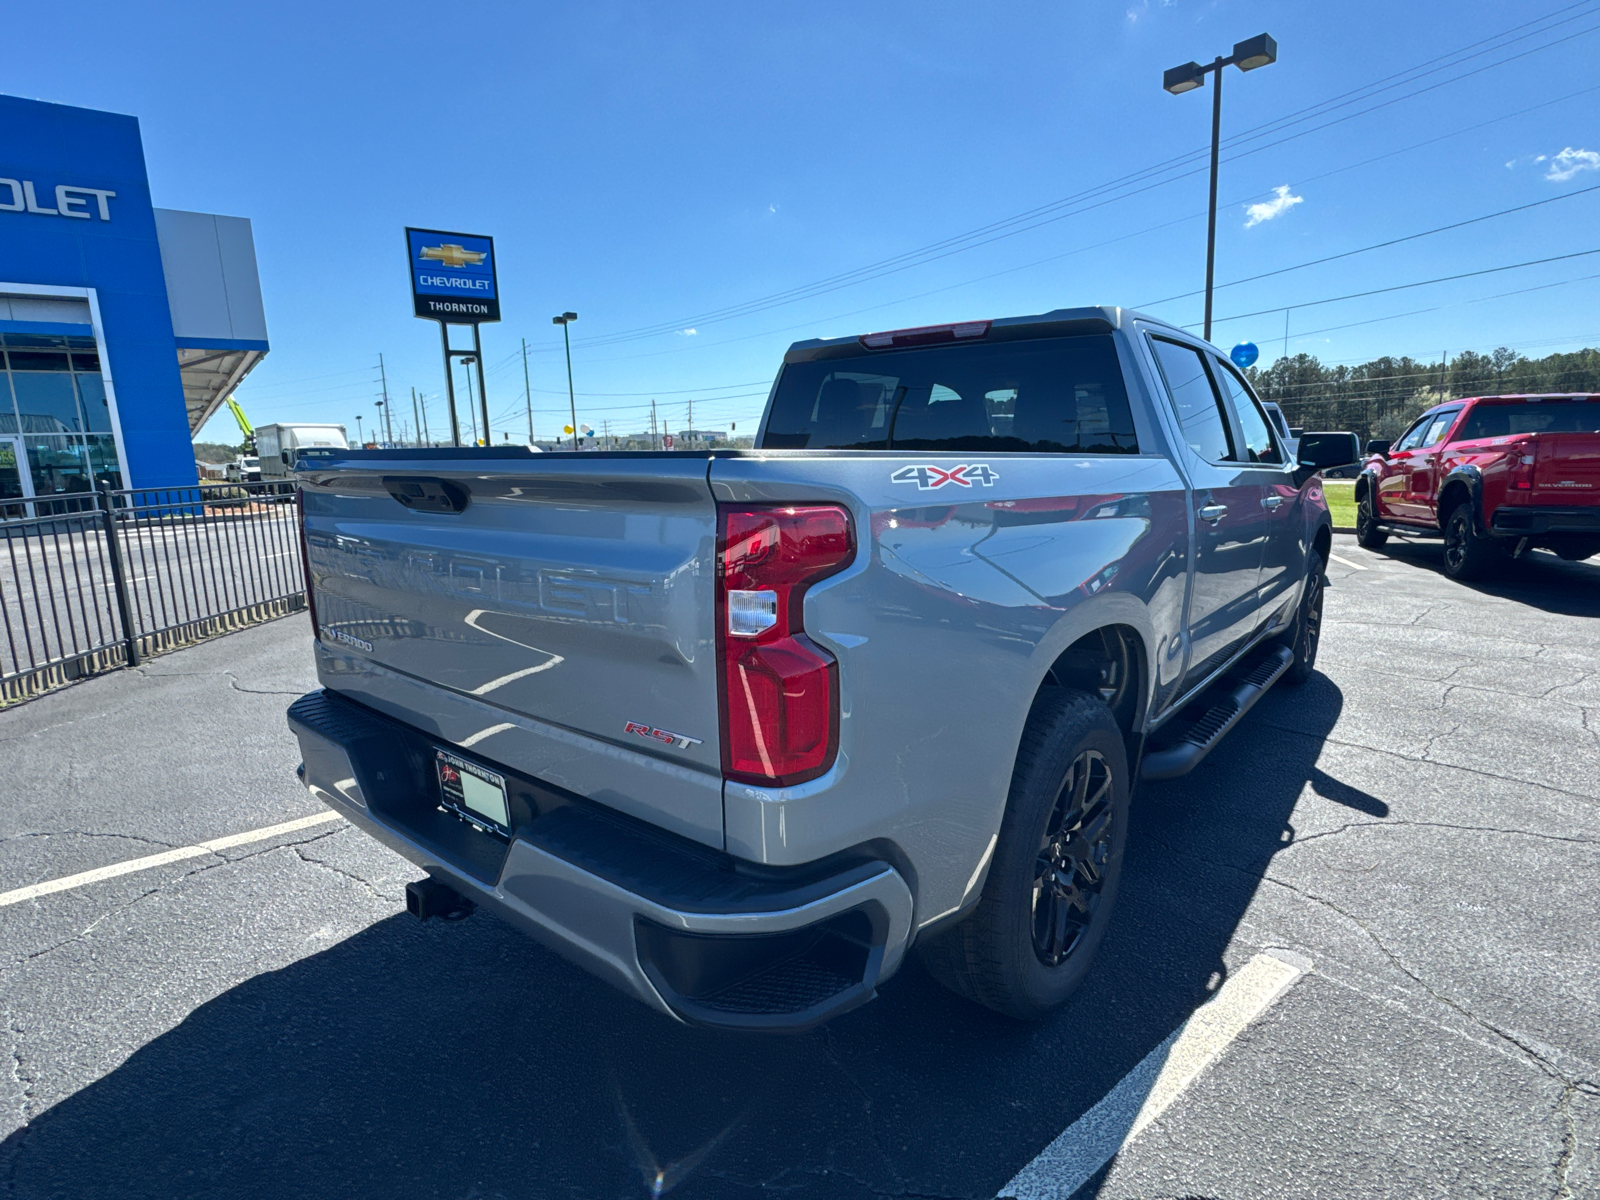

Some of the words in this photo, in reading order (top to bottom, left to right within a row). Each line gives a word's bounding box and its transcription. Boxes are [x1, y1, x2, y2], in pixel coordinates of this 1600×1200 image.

[419, 275, 490, 290] CHEVROLET
[428, 301, 489, 314] THORNTON
[624, 721, 703, 749] RST
[447, 756, 464, 769] JOHN
[464, 763, 500, 785] THORNTON
